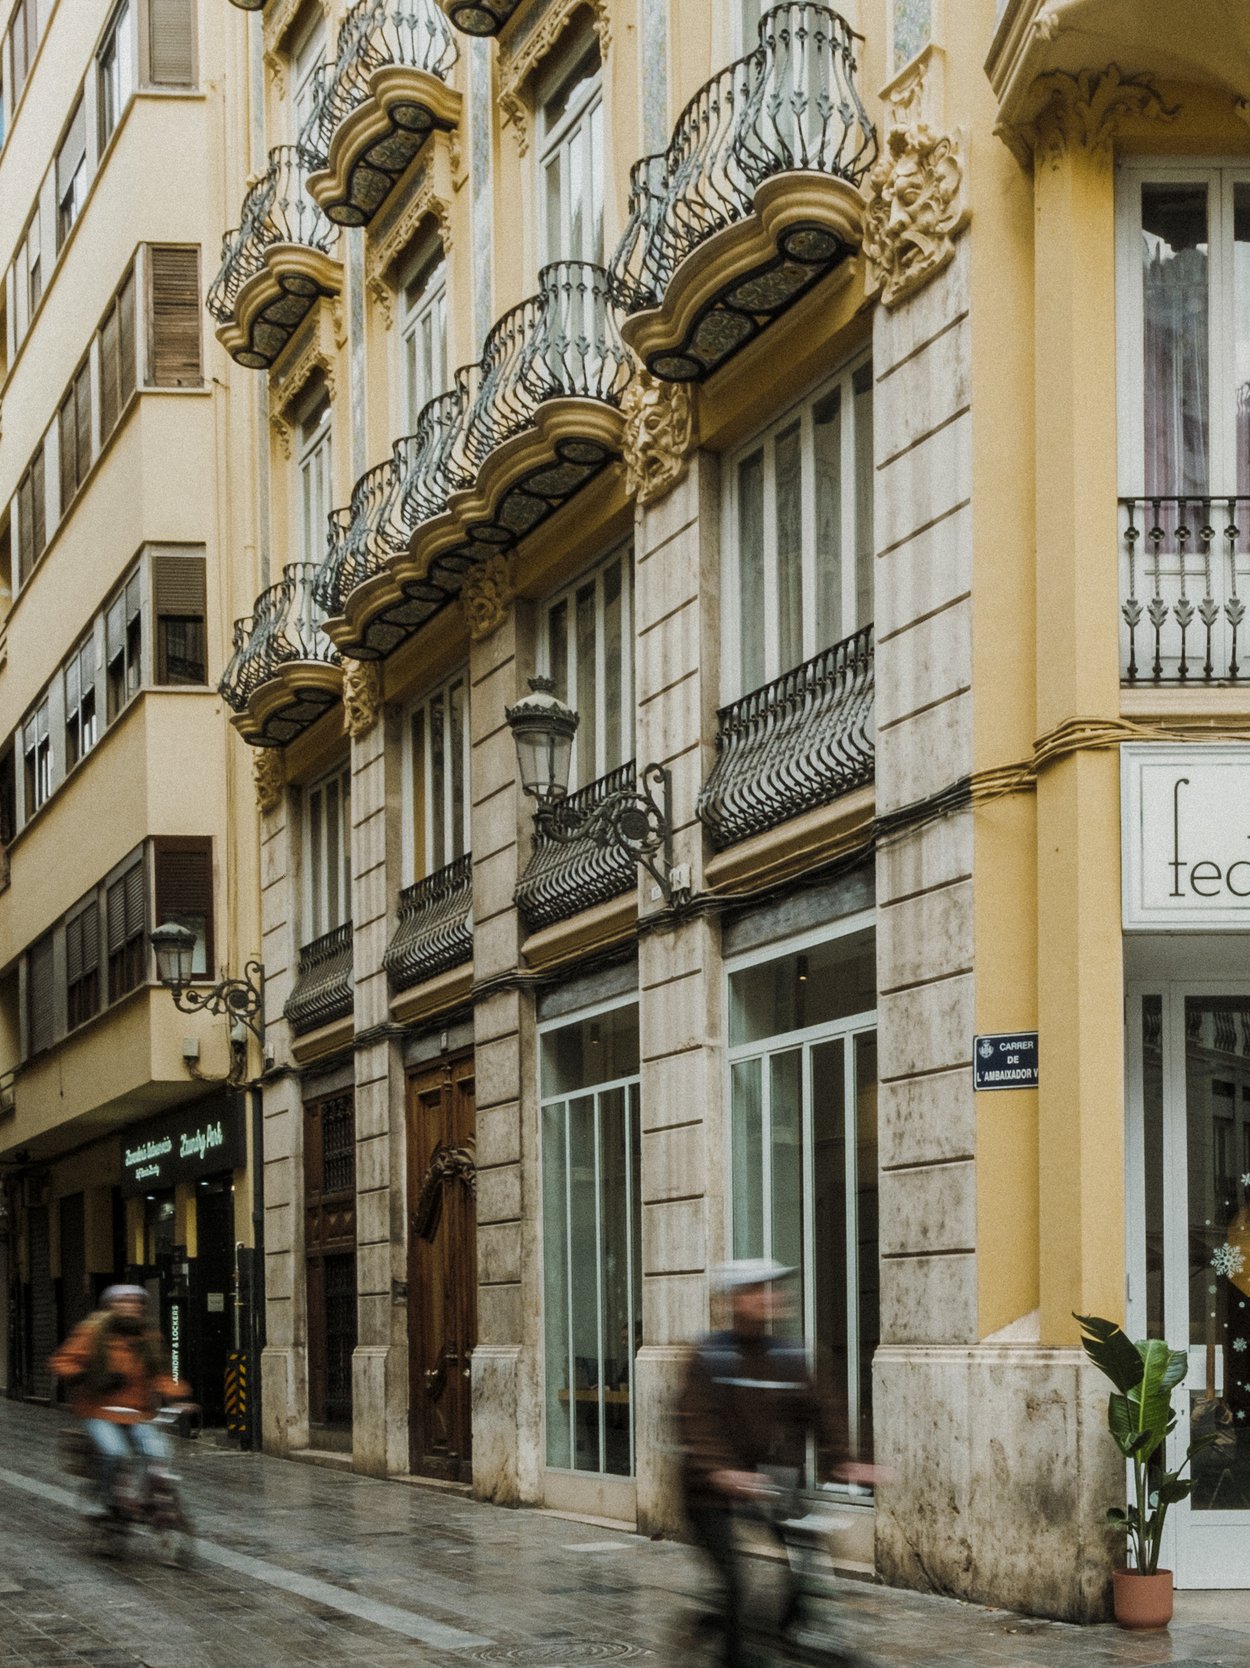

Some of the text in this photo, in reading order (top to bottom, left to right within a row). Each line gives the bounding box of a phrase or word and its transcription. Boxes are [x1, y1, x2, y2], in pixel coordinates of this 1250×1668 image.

[999, 1041, 1034, 1051] CARRER
[1006, 1055, 1019, 1064] DE
[171, 1305, 179, 1340] LOCKERS
